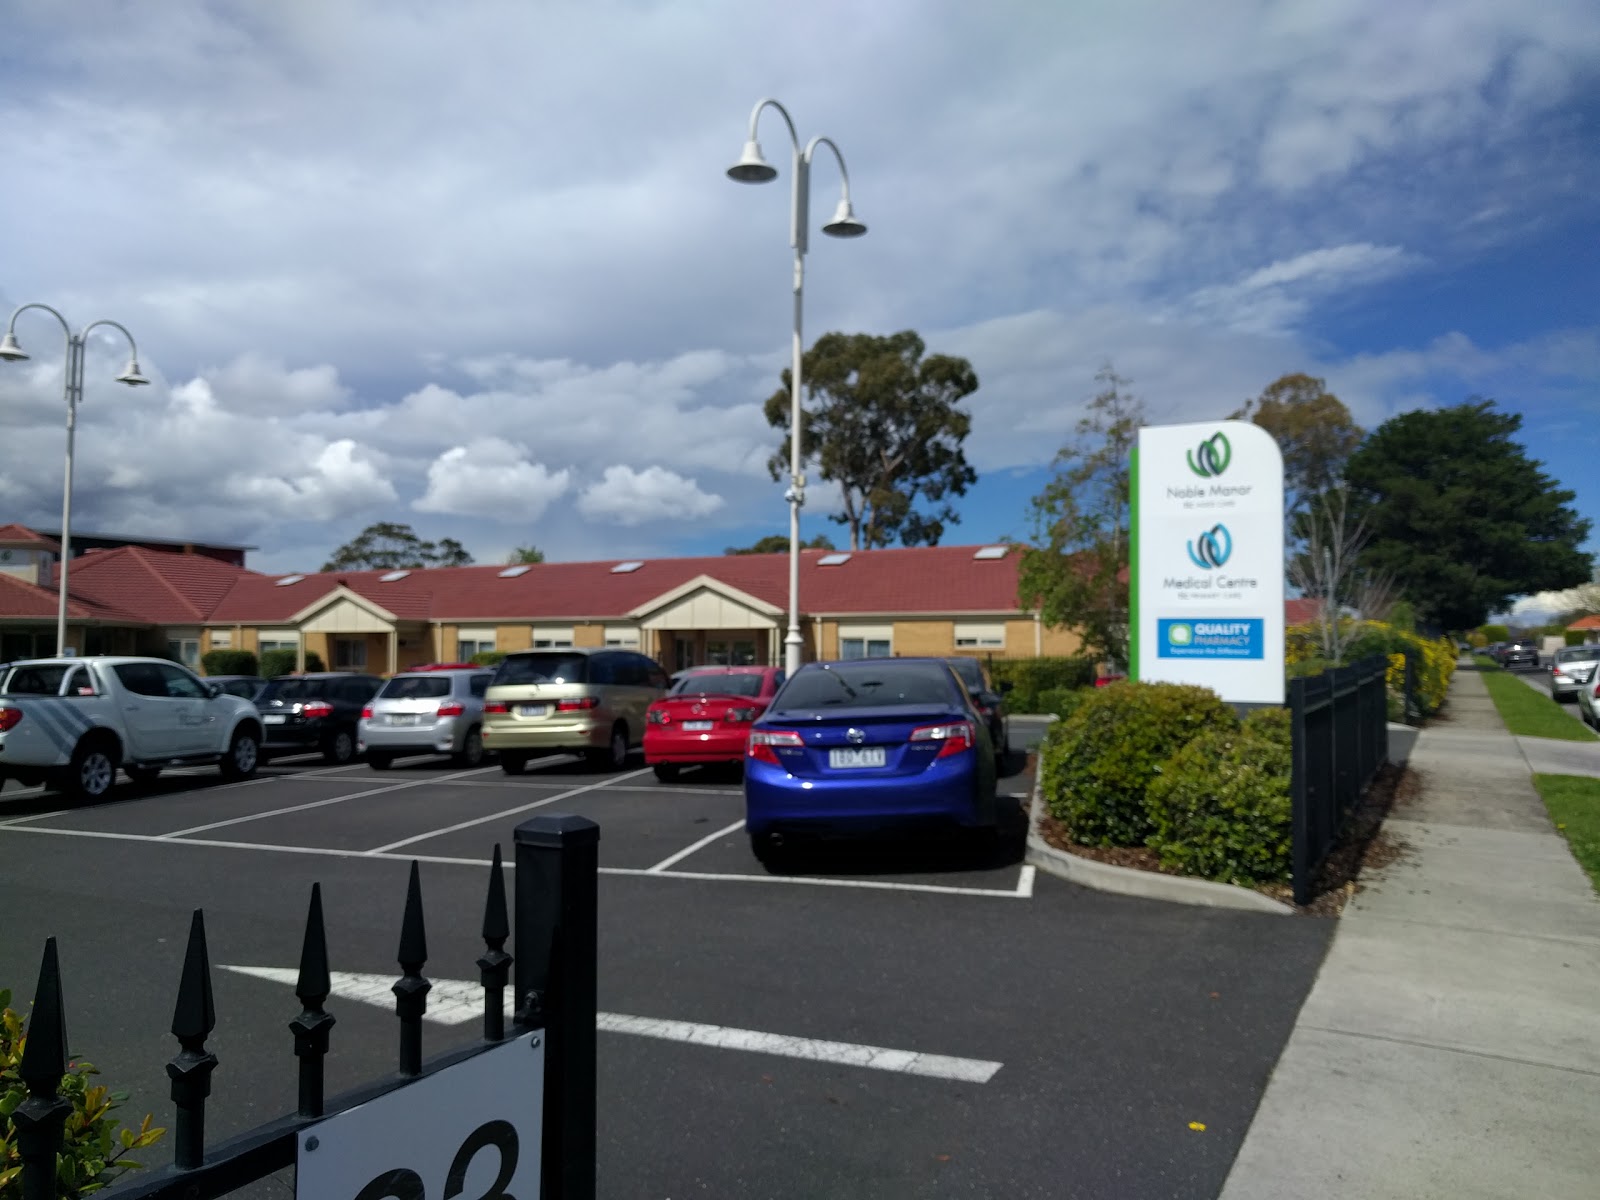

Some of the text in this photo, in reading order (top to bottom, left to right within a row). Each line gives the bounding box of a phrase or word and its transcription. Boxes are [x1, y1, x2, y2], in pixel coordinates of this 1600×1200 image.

[1166, 485, 1252, 499] Noble Manor
[1163, 575, 1257, 589] Medical Centre
[1194, 622, 1251, 636] QUALITY
[1194, 635, 1250, 647] PHARMACY
